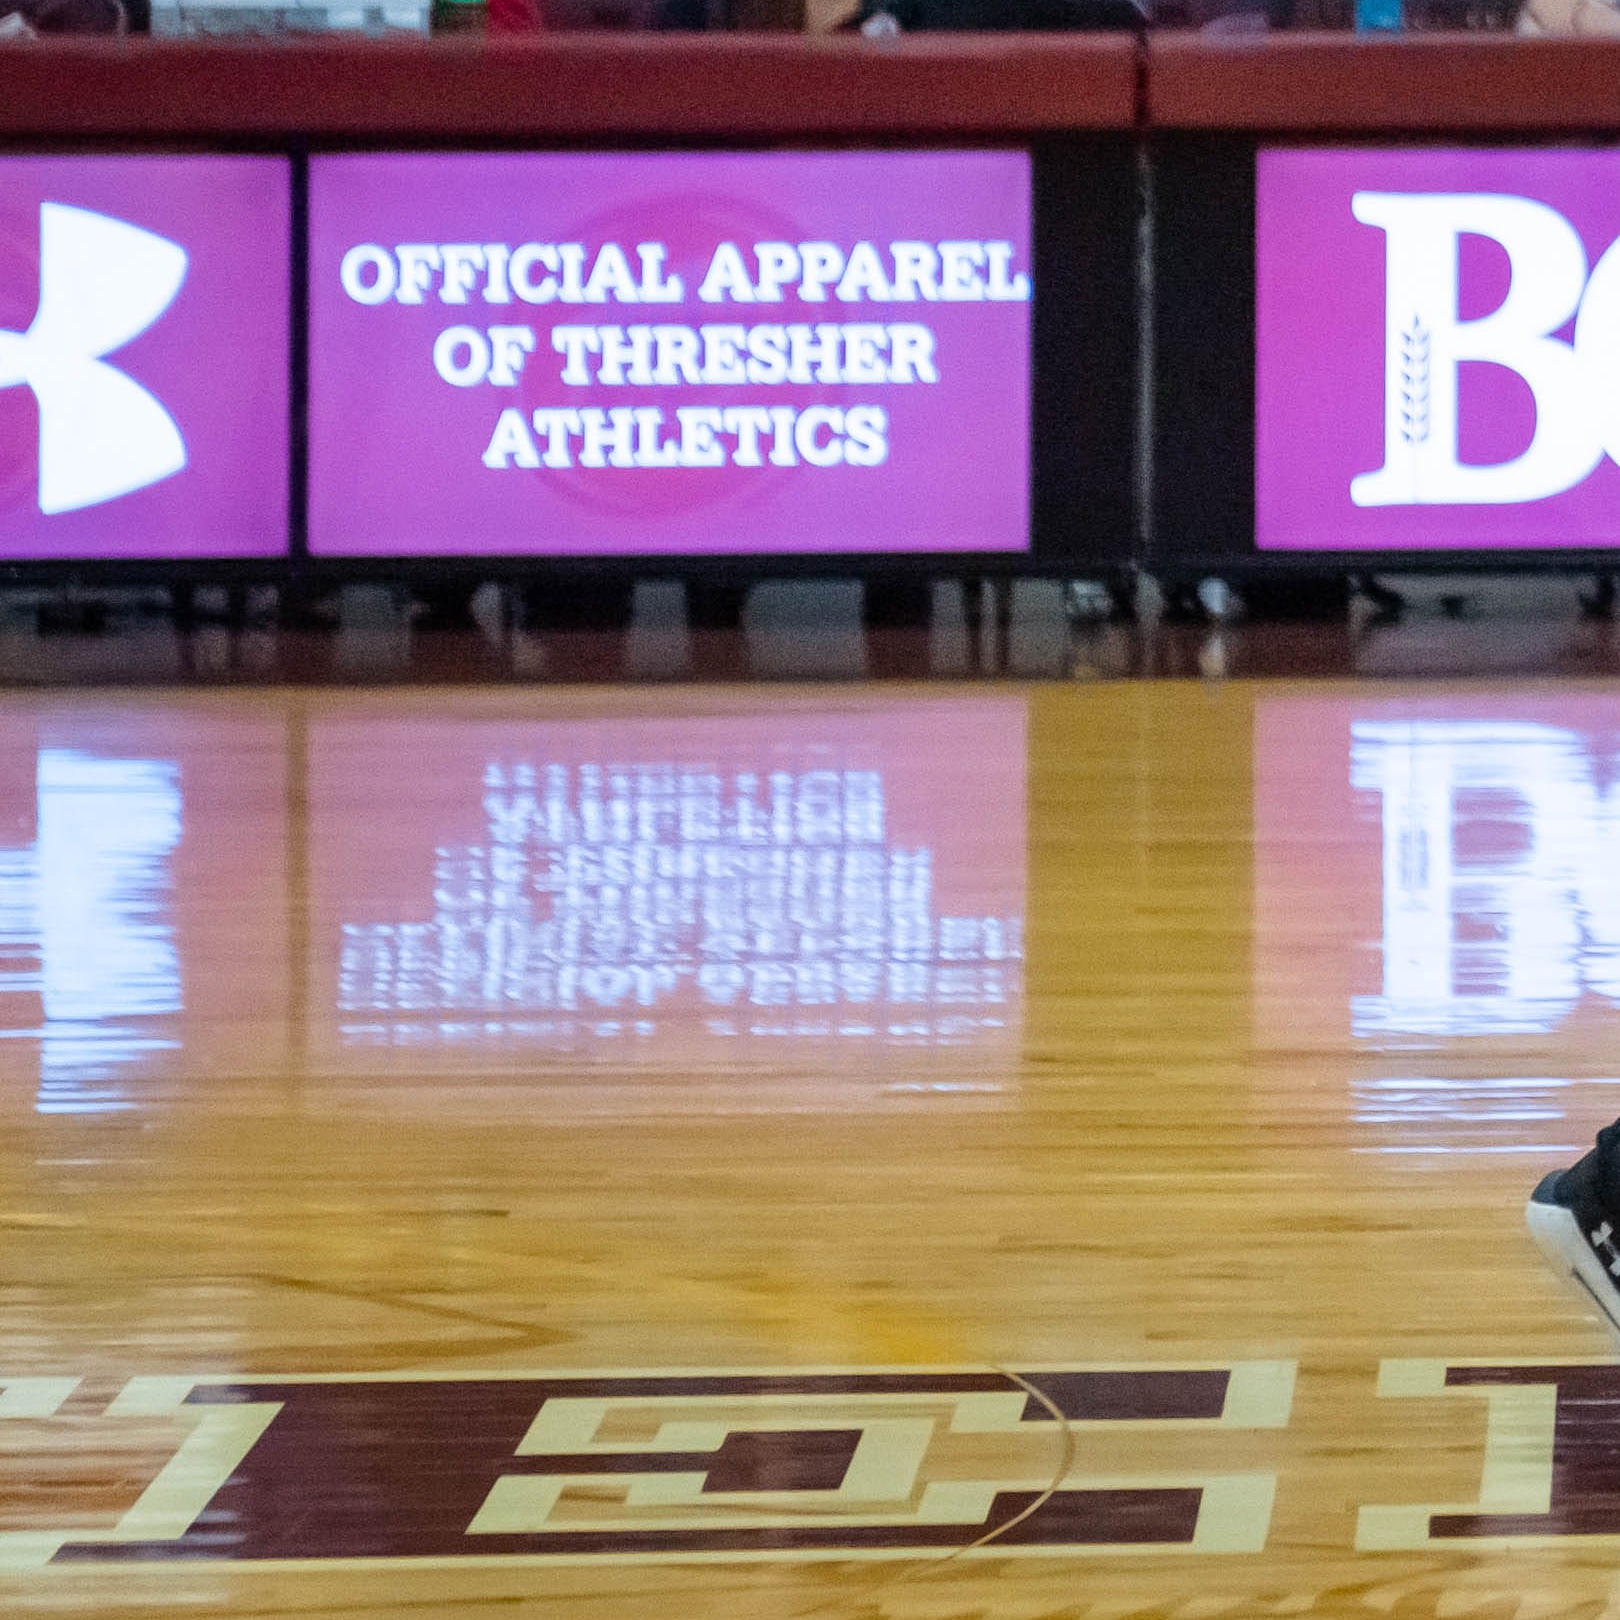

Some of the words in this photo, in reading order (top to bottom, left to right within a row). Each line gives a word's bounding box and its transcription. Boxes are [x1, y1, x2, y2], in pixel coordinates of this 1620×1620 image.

[339, 241, 684, 305] OFFICIAL
[697, 241, 1031, 303] APPAREL
[432, 324, 535, 386] OF
[551, 323, 938, 385] THRESHER
[481, 405, 889, 469] ATHLETICS
